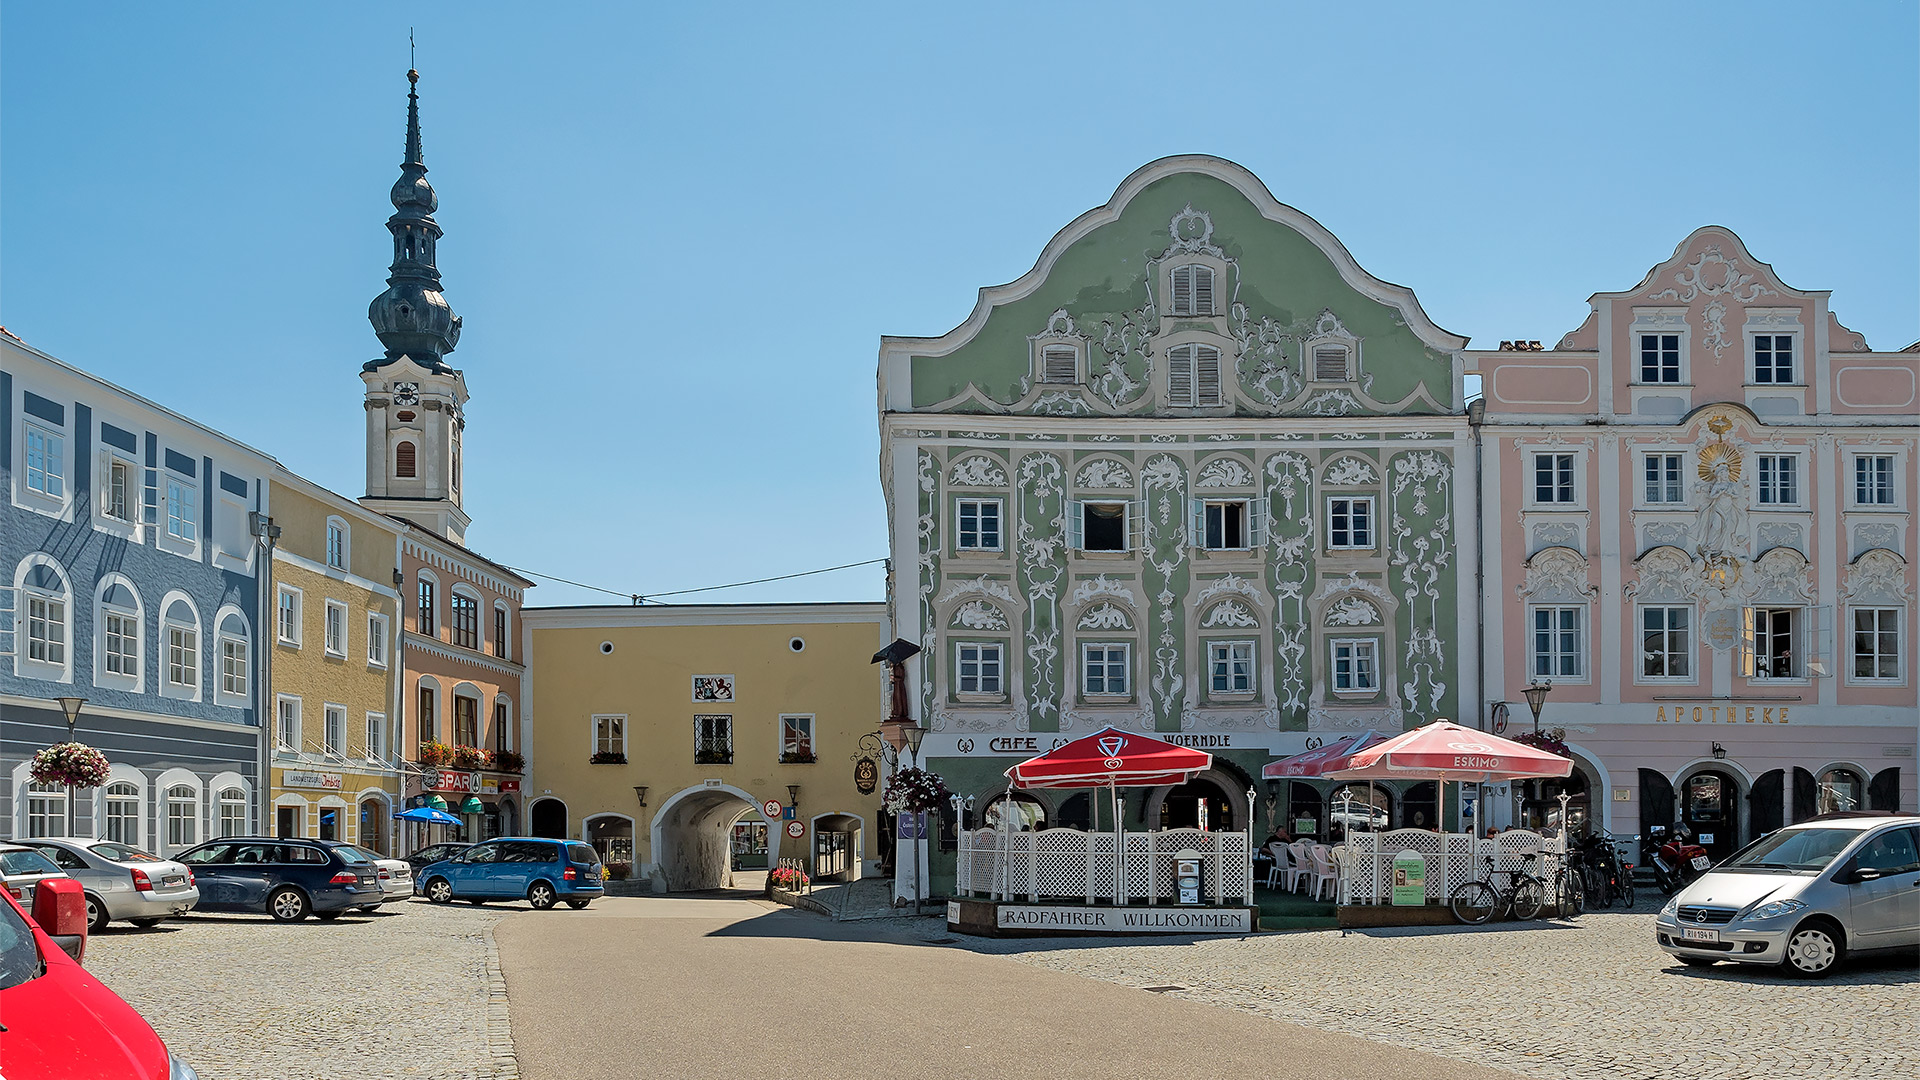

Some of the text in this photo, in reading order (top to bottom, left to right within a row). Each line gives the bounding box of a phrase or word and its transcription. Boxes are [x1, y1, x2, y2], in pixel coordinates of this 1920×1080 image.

[1656, 706, 1789, 724] APOTHEKE
[990, 737, 1041, 752] CAFE
[1163, 735, 1231, 747] WOERNDLE
[1454, 756, 1500, 768] ESKIMO
[1286, 765, 1305, 775] ESKIMO
[437, 772, 470, 790] SPAR
[1006, 911, 1242, 927] RADFAHRER WILLKOMMEN
